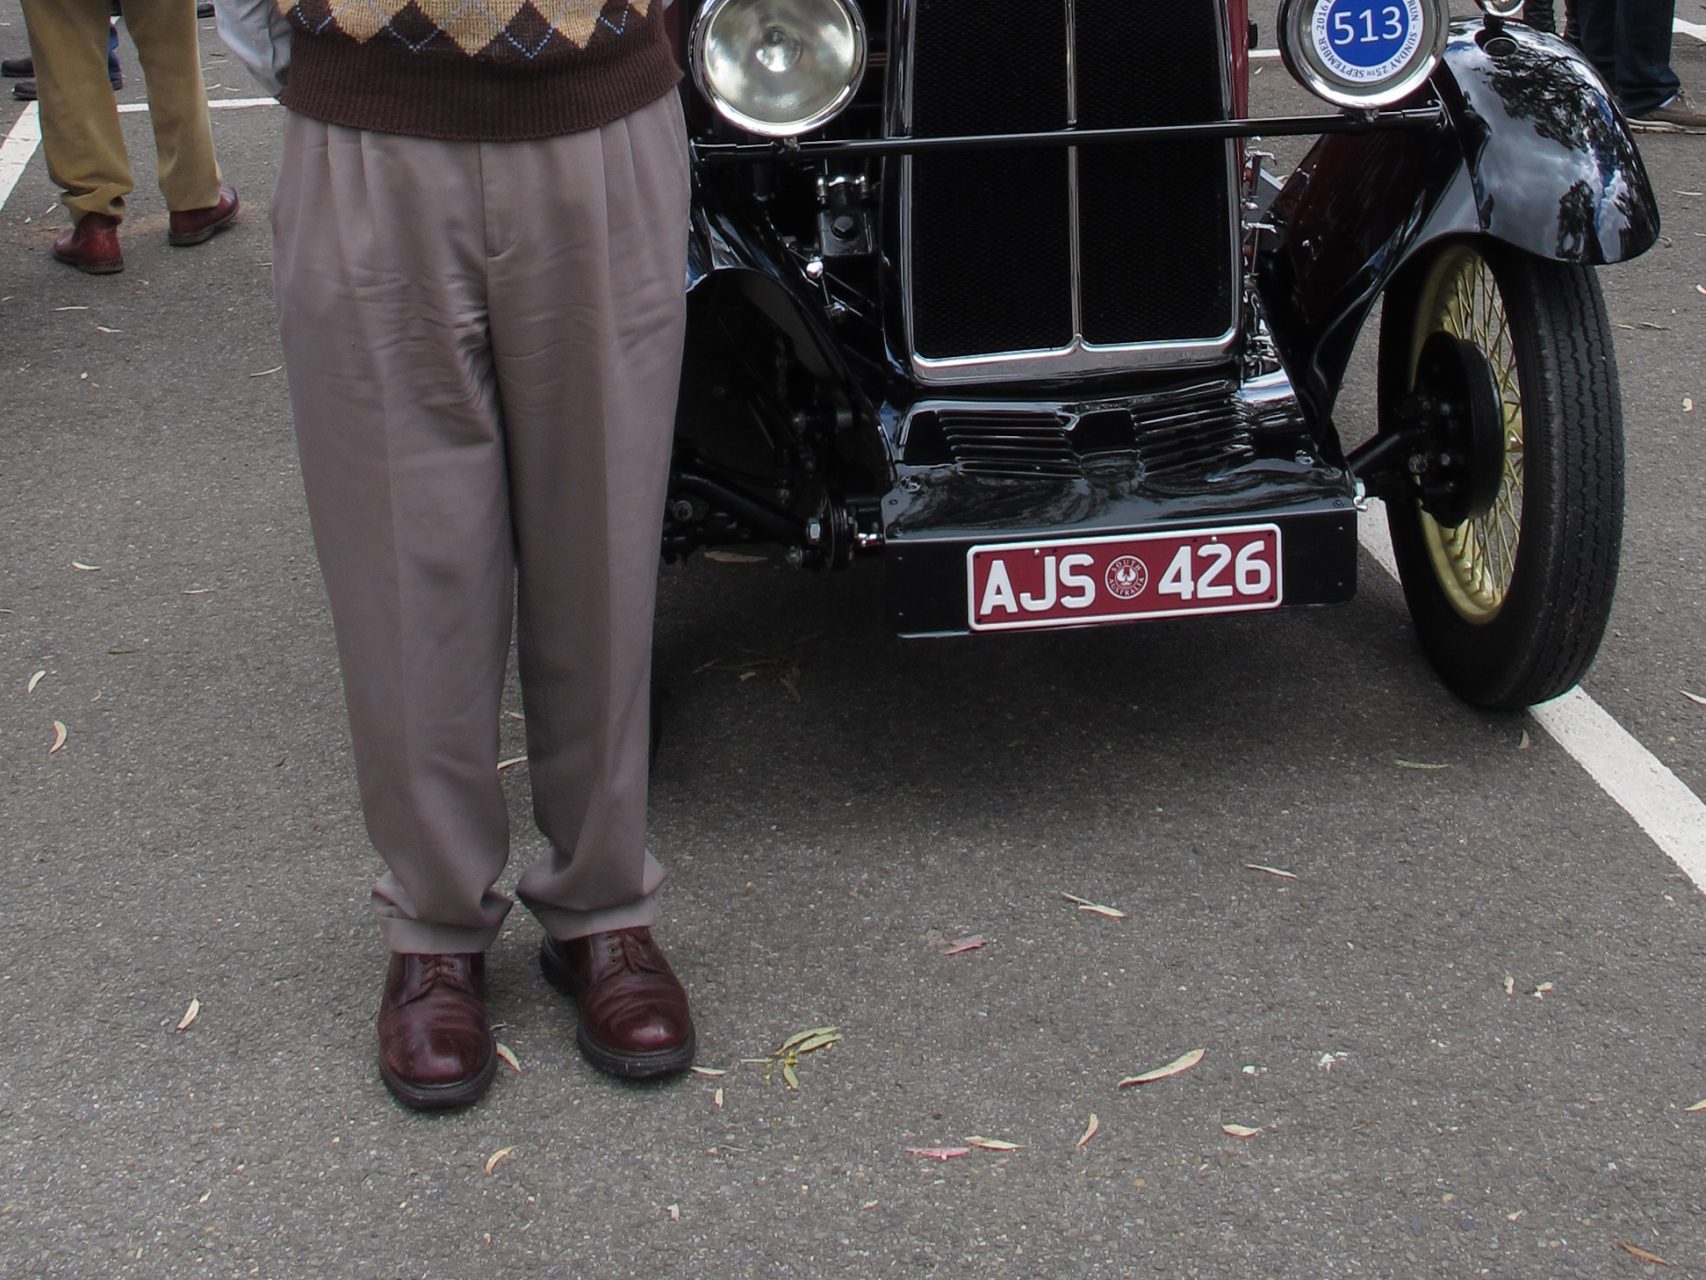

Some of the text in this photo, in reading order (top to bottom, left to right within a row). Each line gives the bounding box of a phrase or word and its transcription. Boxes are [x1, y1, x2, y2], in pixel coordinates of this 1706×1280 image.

[1333, 5, 1403, 45] 513
[1317, 37, 1365, 78] SEPTEMBER
[1390, 31, 1418, 71] SUNDAY
[1366, 67, 1389, 77] 25TH
[979, 540, 1272, 616] AJS 426
[1111, 559, 1142, 572] SOUTH
[1109, 577, 1145, 597] AUSTRALIA
